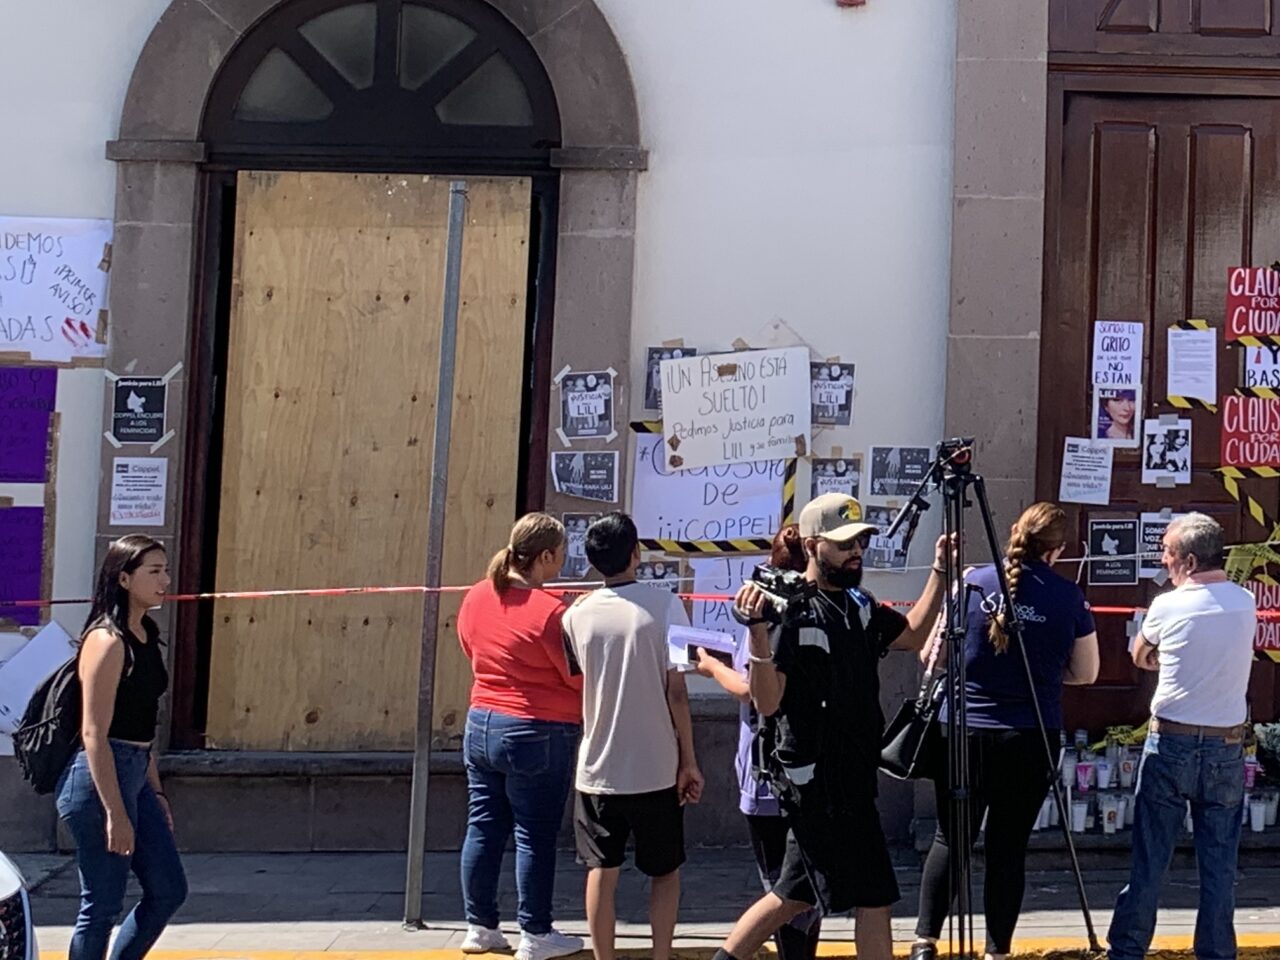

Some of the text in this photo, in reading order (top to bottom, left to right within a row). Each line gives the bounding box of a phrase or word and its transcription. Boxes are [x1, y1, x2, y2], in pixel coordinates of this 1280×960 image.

[0, 231, 64, 259] DEMOS
[1251, 296, 1280, 309] POR
[1101, 335, 1131, 353] GRITO
[1108, 362, 1124, 372] NO
[819, 393, 839, 404] LILI
[577, 403, 598, 416] LILI
[768, 413, 795, 437] para
[1250, 432, 1280, 443] POR
[703, 482, 740, 506] De
[1144, 526, 1168, 534] SOMO
[876, 539, 896, 549] LILI
